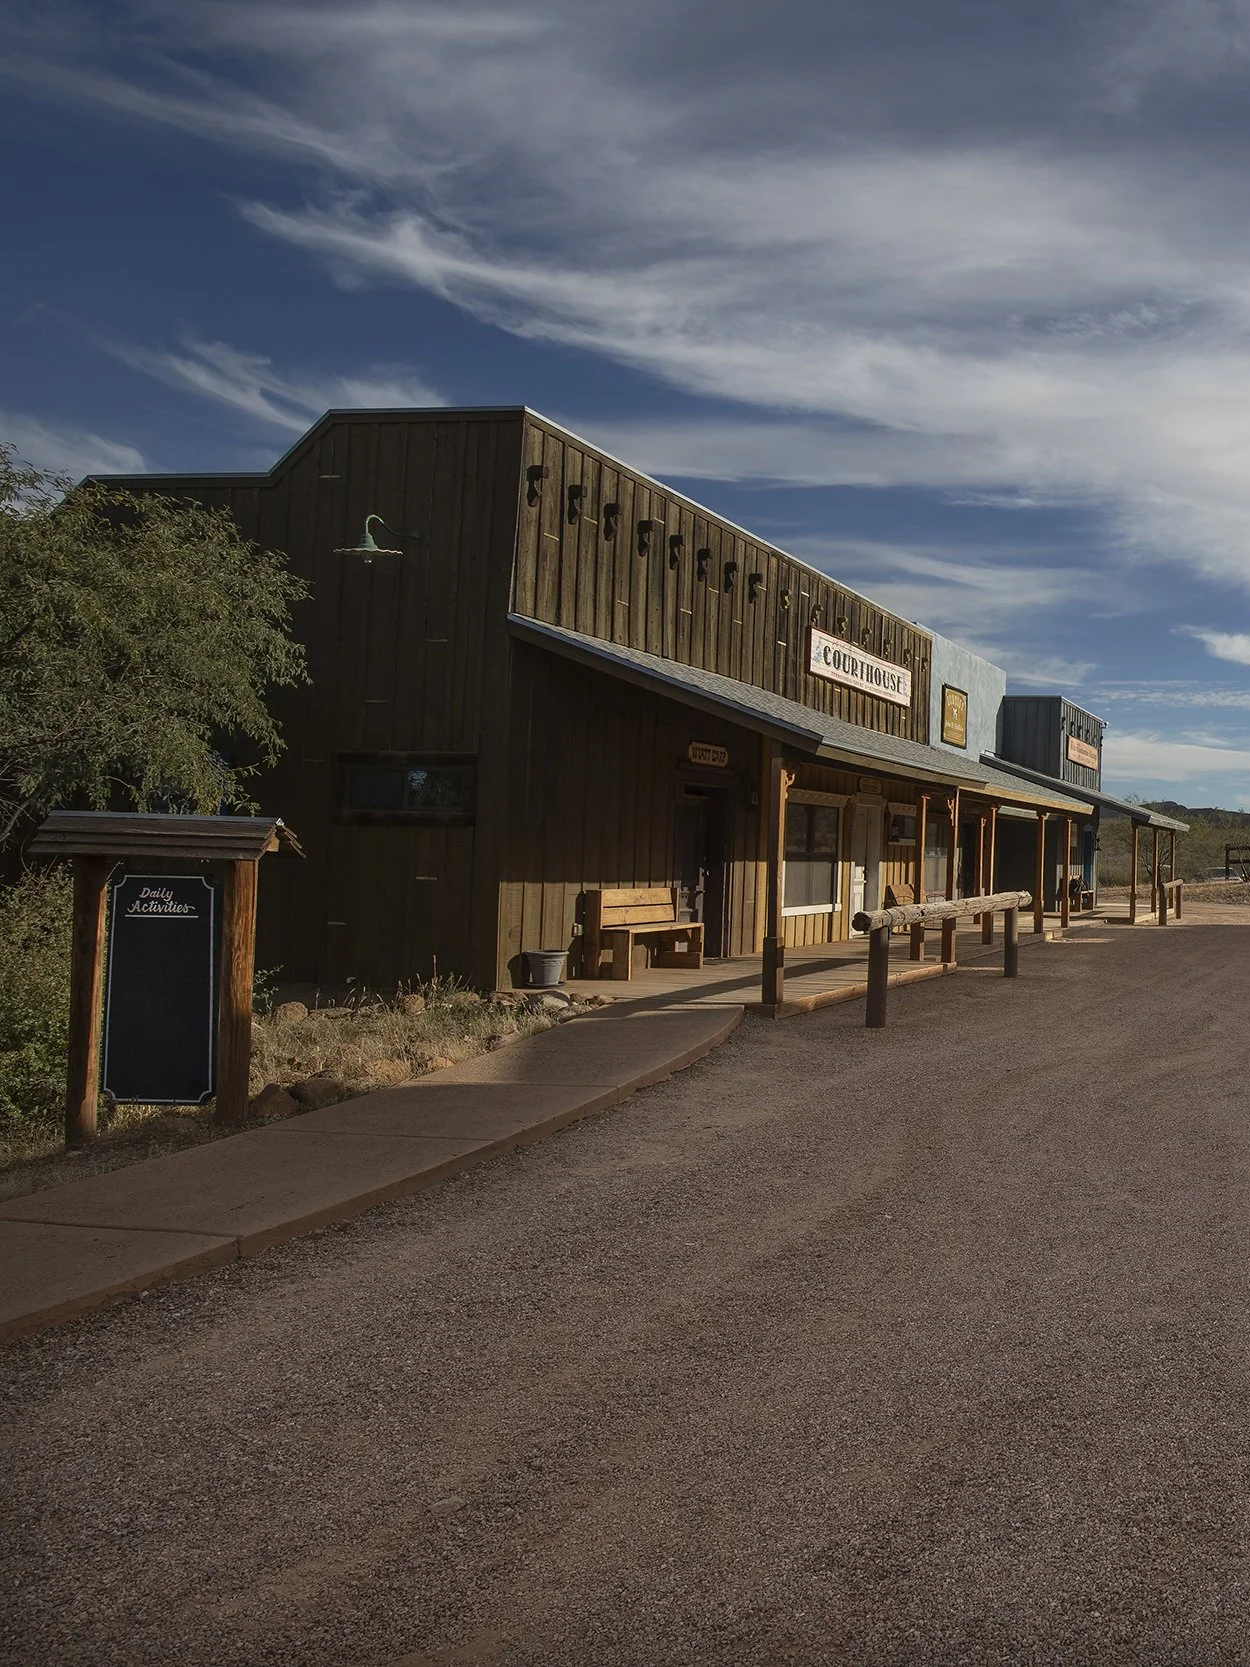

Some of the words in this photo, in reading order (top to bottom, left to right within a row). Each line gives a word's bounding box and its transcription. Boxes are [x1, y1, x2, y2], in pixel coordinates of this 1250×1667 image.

[823, 645, 903, 694] COURTHOUSE
[138, 887, 174, 902] Daily
[126, 899, 196, 914] Activities
